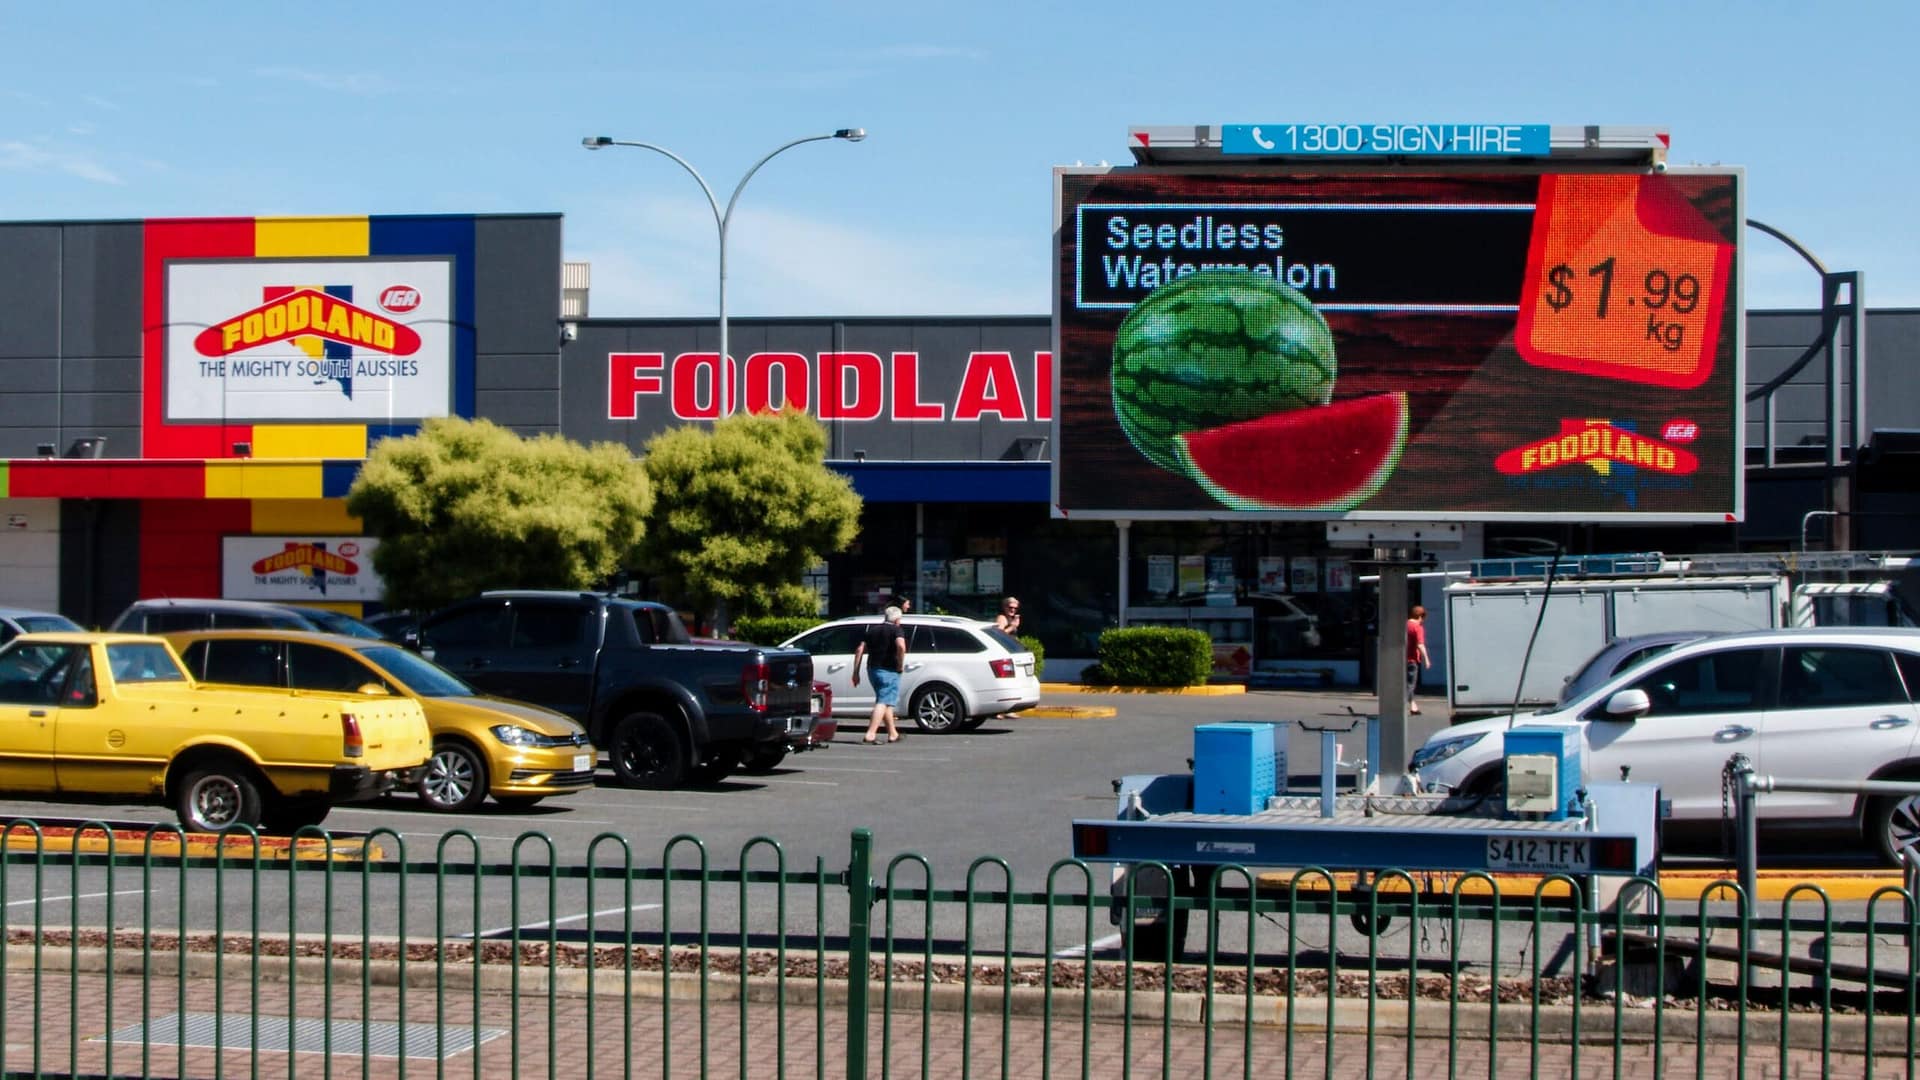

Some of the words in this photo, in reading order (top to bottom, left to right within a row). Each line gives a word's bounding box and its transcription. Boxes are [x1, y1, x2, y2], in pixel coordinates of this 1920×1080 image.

[1285, 125, 1363, 152] 1300
[1372, 125, 1443, 152] SIGN
[1452, 125, 1521, 153] HIRE
[1107, 216, 1284, 249] Seedless
[383, 290, 418, 306] IGA
[222, 296, 396, 350] FOODLAND
[1646, 313, 1684, 351] kg
[199, 361, 225, 377] THE
[232, 361, 291, 377] MIGHTY
[297, 360, 351, 377] SOUTH
[356, 360, 418, 377] AUSSIES
[608, 352, 1052, 421] FOODLA
[1522, 429, 1676, 471] FOODLAND
[264, 547, 346, 571] FOODLAND
